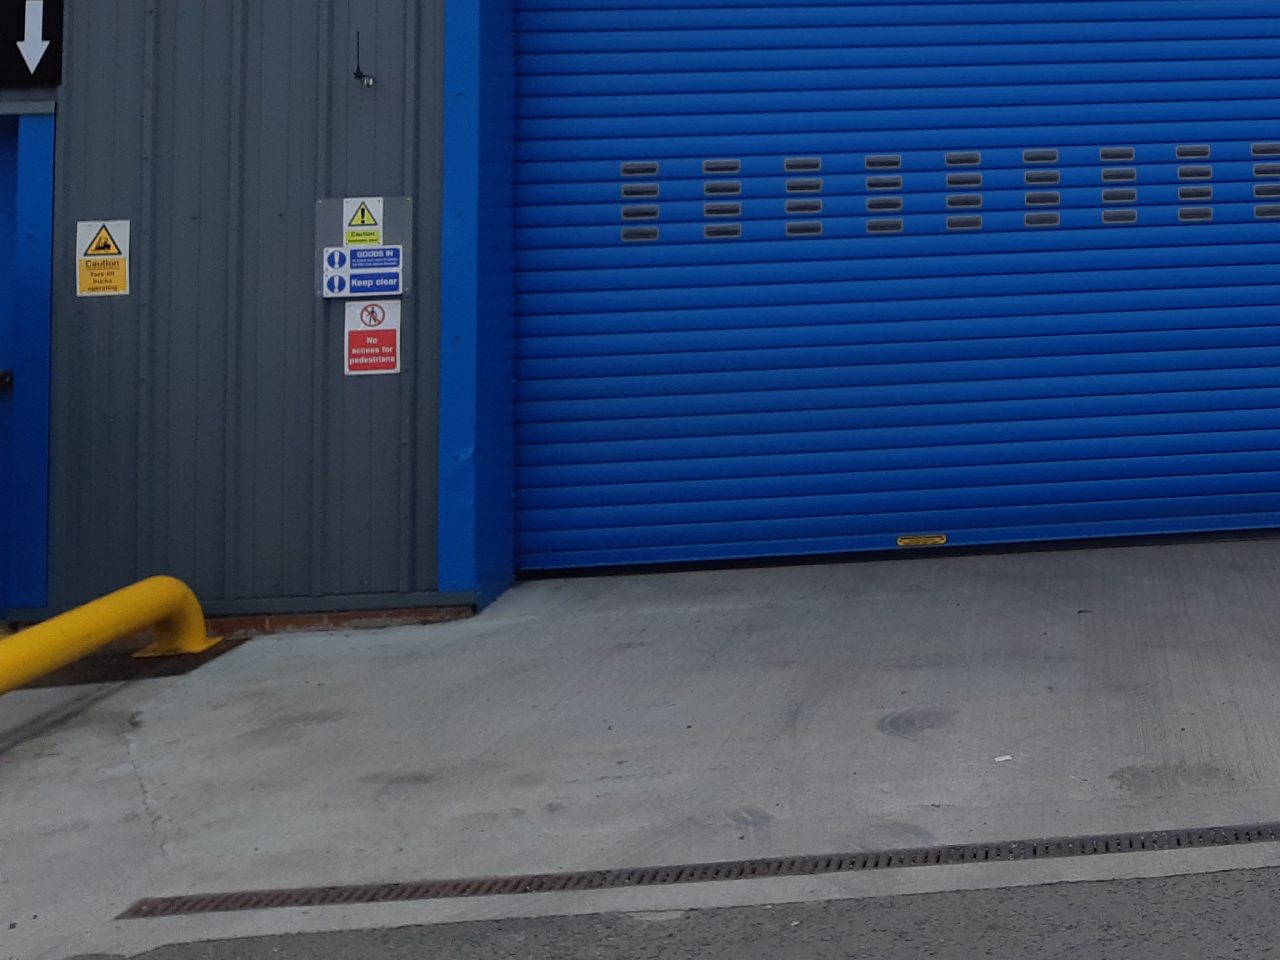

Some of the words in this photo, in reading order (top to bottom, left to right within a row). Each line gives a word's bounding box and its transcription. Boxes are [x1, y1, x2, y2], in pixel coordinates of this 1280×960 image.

[385, 249, 394, 257] IN
[85, 259, 120, 268] Caution
[351, 278, 374, 288] Keep
[375, 277, 397, 286] clear
[366, 336, 378, 344] No
[351, 347, 380, 355] access
[349, 355, 395, 365] pedestrians
